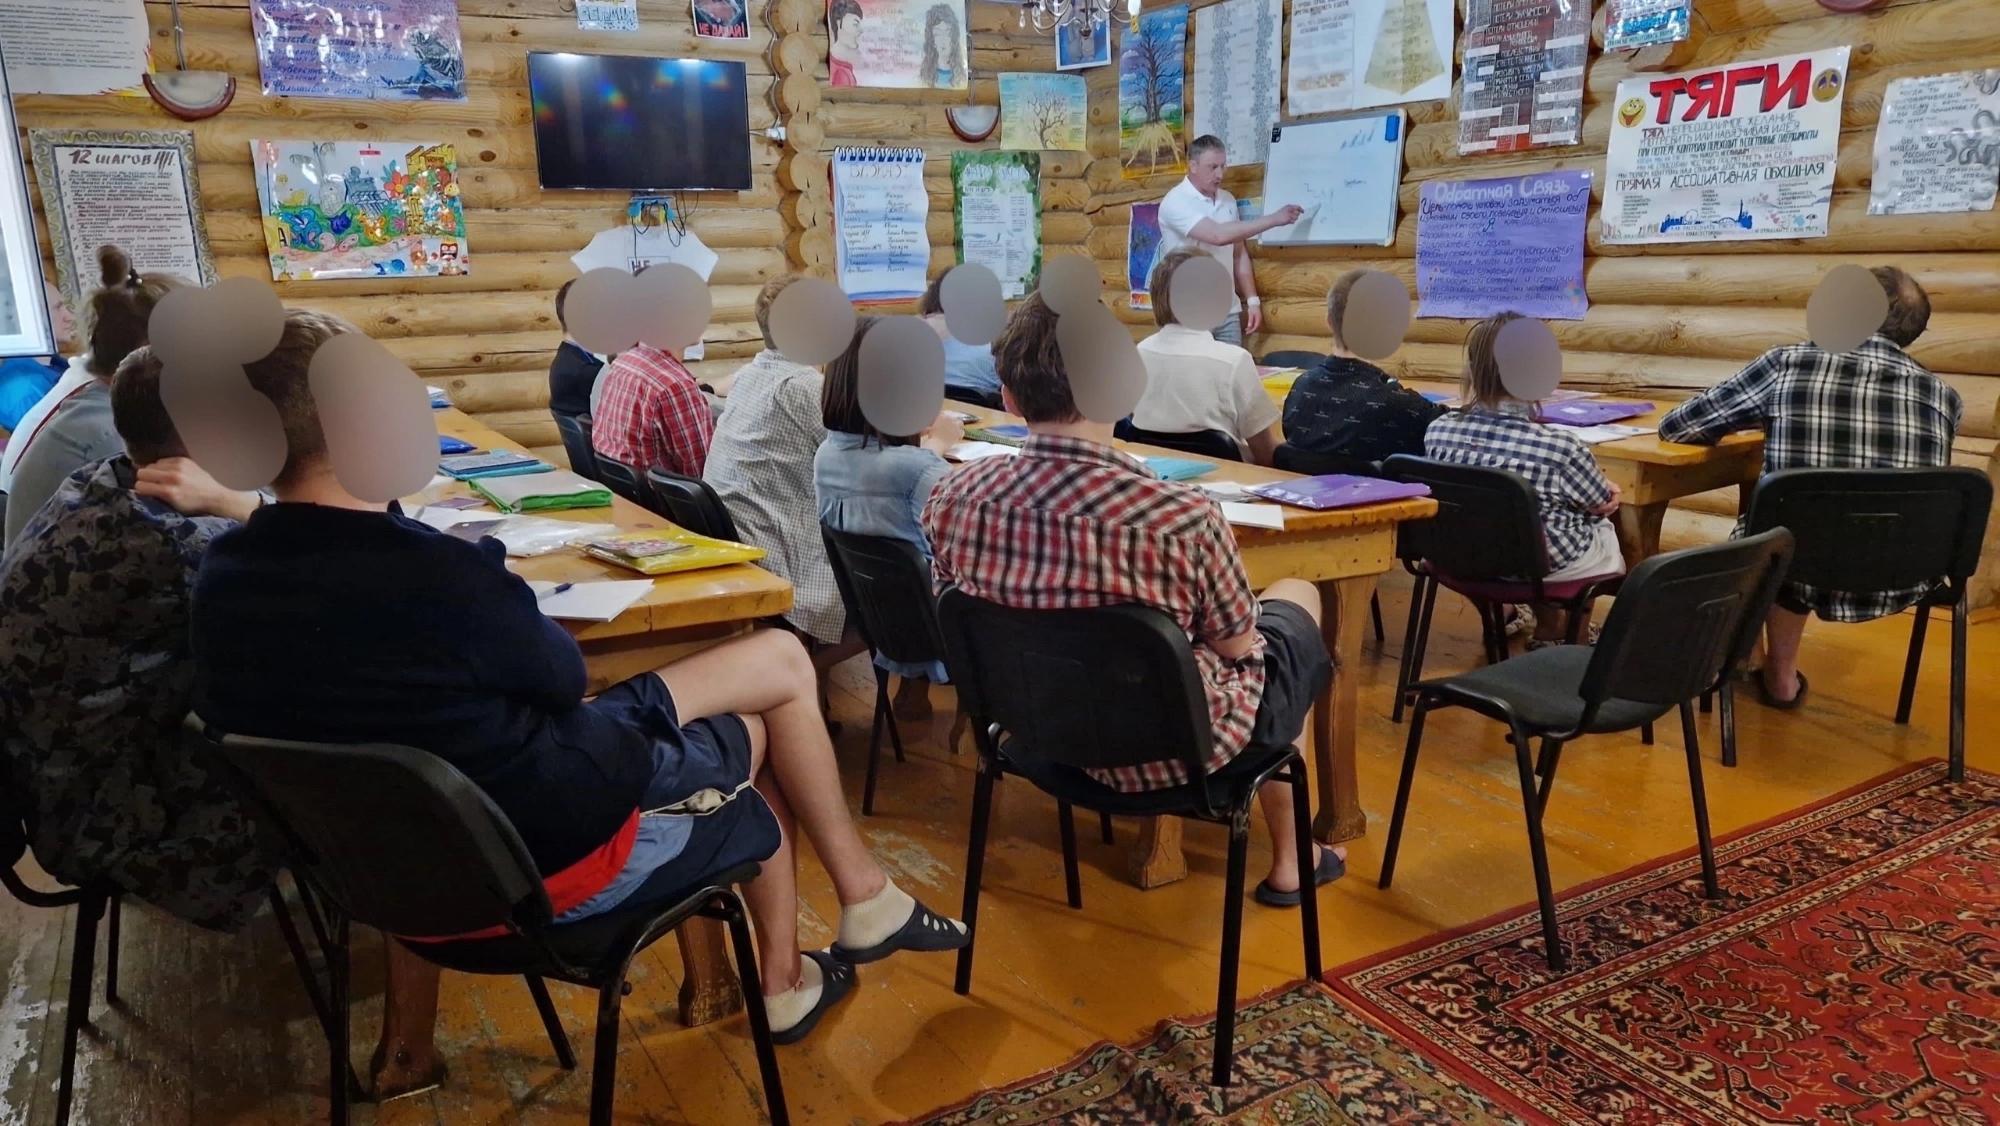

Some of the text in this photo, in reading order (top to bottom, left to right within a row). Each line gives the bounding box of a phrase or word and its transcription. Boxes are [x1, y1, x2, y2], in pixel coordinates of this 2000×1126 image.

[1650, 59, 1812, 124] ТЯГИ
[1748, 111, 1798, 126] ЖЕЛАНИЕ
[68, 149, 92, 165] 12
[1615, 162, 1825, 191] ПРЯМАЯ АССОЦИАТИВНАЯ ОБХОДНАЯ
